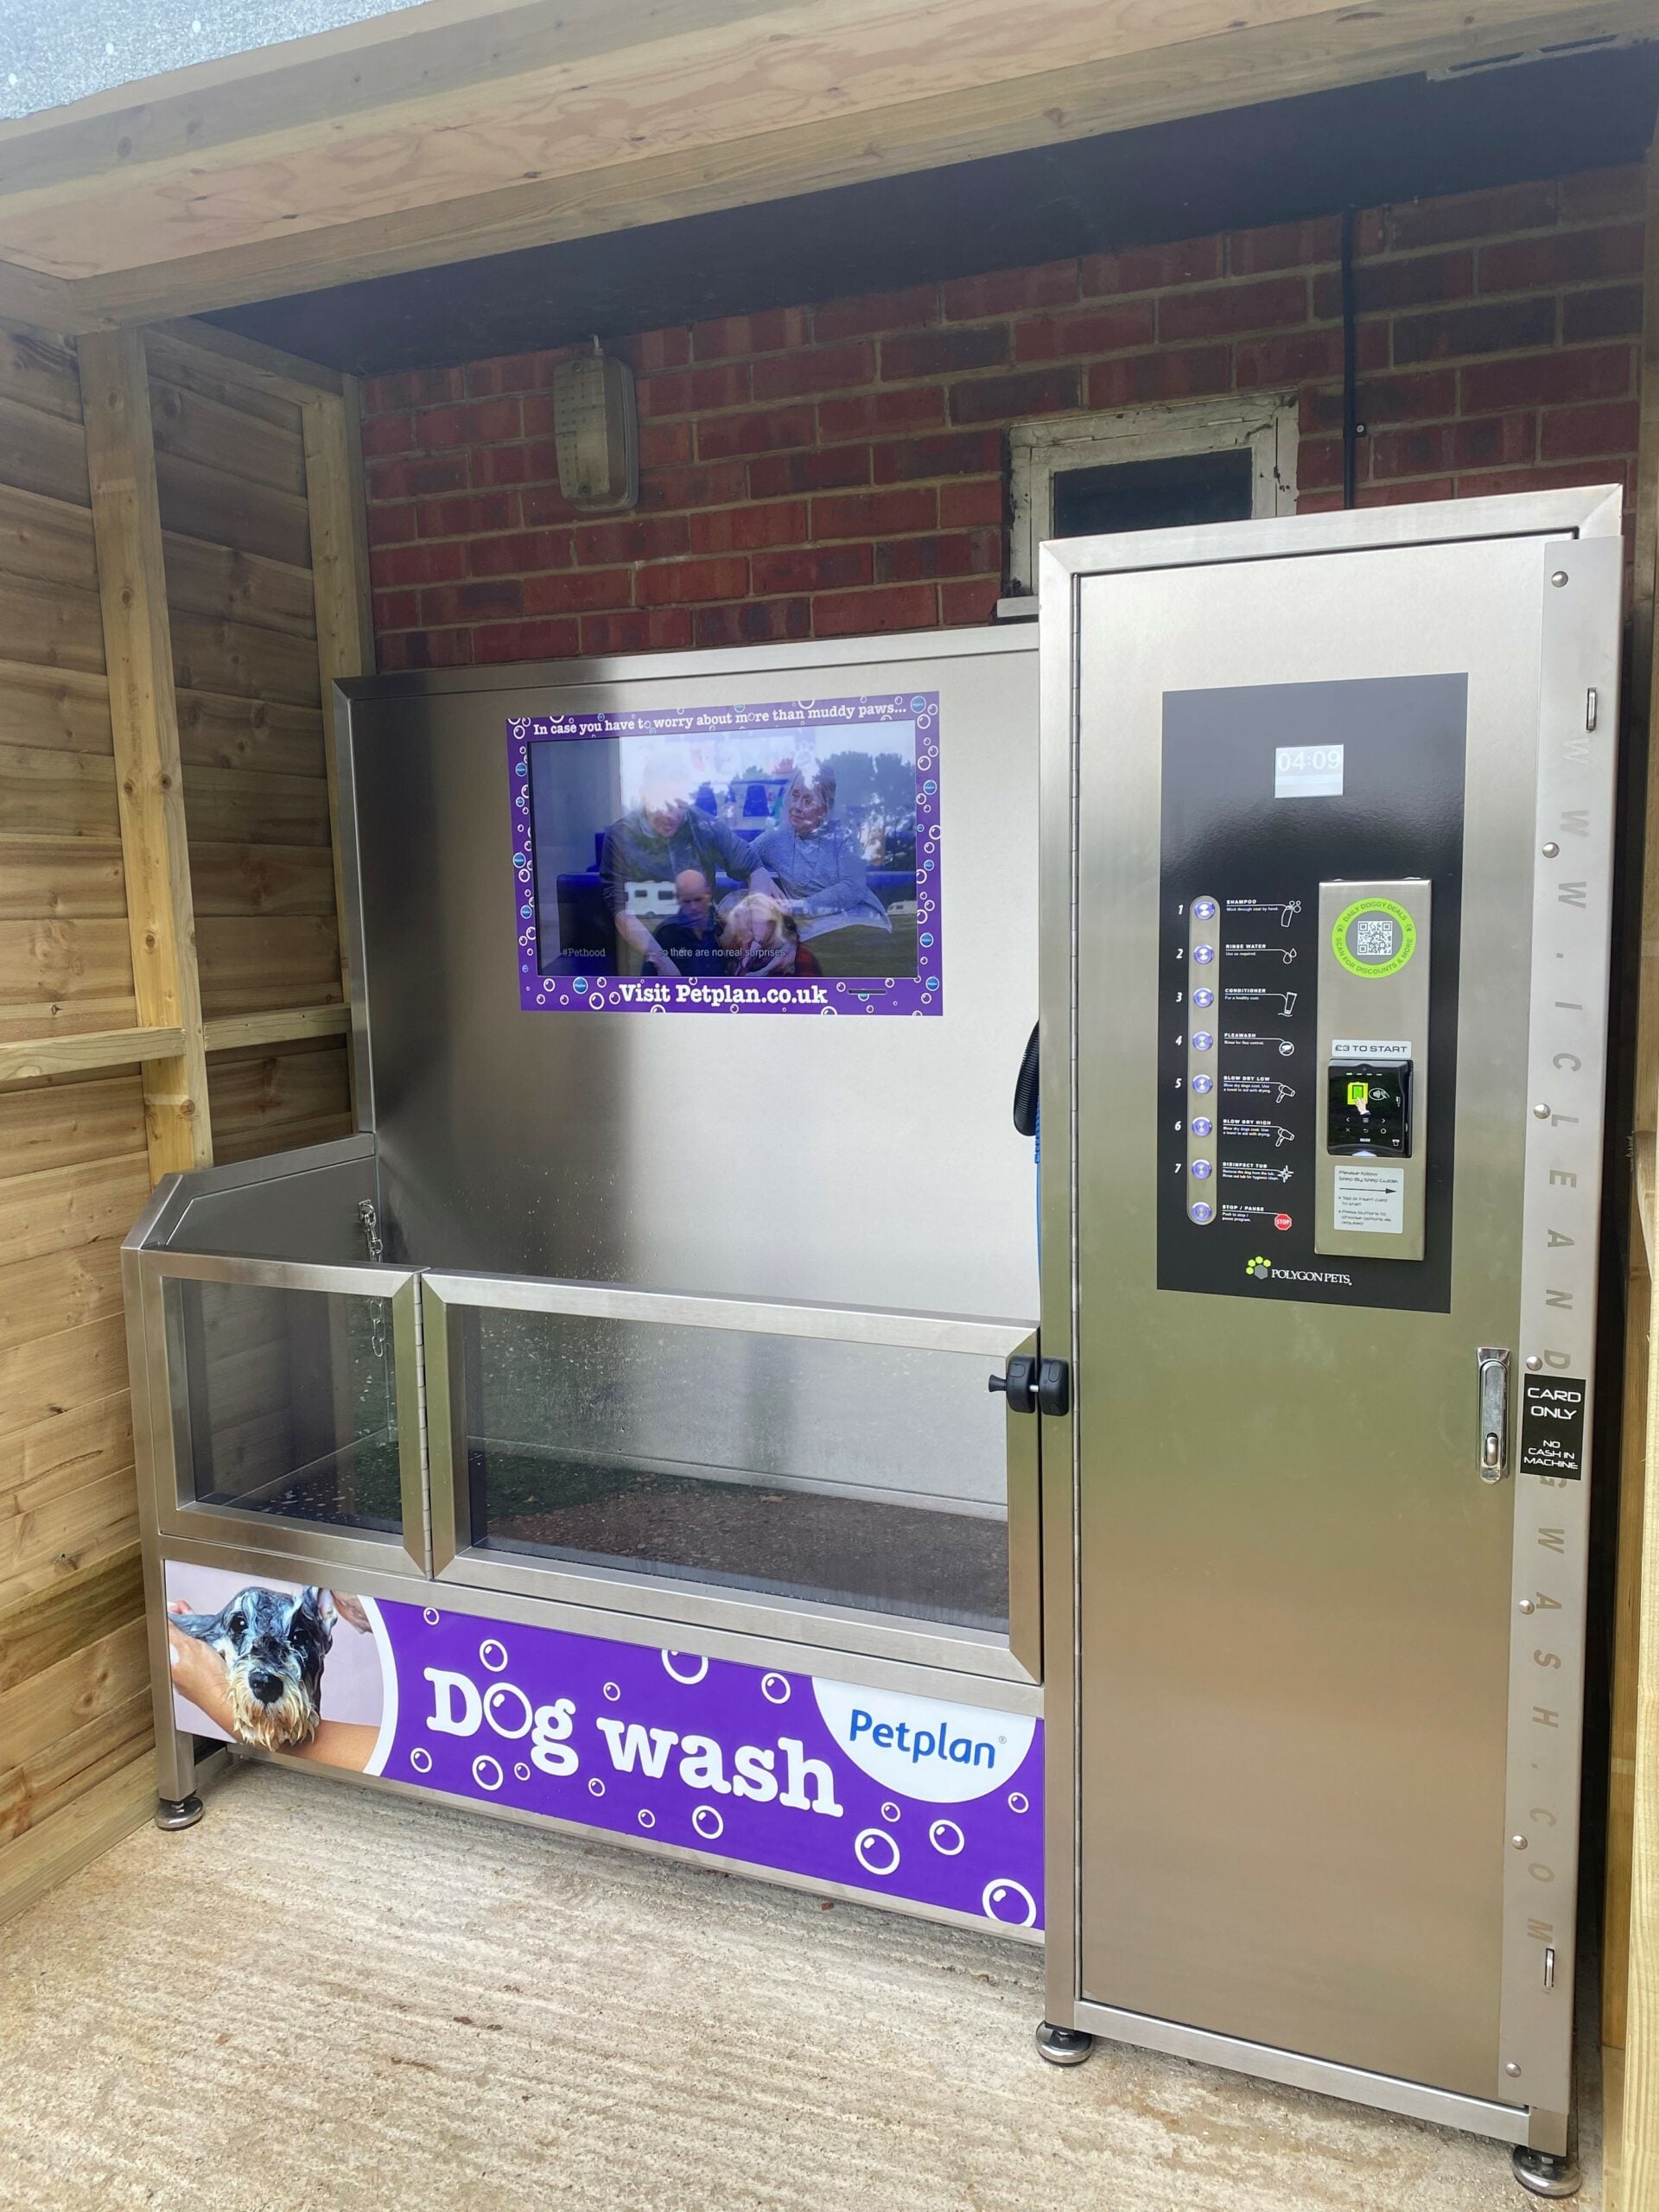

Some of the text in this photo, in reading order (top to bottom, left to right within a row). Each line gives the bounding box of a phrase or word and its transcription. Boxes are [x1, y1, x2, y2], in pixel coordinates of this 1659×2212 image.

[534, 724, 548, 734] In
[550, 724, 576, 734] case
[579, 722, 602, 735] you
[605, 720, 633, 731] have
[653, 717, 694, 729] worry
[696, 713, 733, 726] about
[735, 711, 769, 723] more
[772, 709, 804, 721] than
[808, 704, 855, 719] muddy
[857, 703, 907, 717] paws...
[1278, 750, 1340, 772] 04:09
[1178, 905, 1184, 915] 1
[1343, 907, 1359, 922] DAILY
[1388, 905, 1408, 921] DEALS
[563, 948, 606, 957] #Pethood
[671, 948, 693, 957] there
[726, 948, 742, 957] real
[1176, 949, 1183, 959] 2
[1343, 956, 1356, 968] FOR
[1356, 962, 1397, 974] DISCOUNTS
[1402, 938, 1413, 959] MORE
[619, 983, 828, 1007] Visit Petplan.co.uk
[1176, 992, 1183, 1002] 3
[1175, 1035, 1183, 1046] 4
[1175, 1078, 1182, 1089] 5
[1175, 1121, 1181, 1131] 6
[1175, 1164, 1182, 1173] 7
[1271, 1268, 1323, 1281] POLYGON
[1528, 1387, 1581, 1402] CARD
[1530, 1406, 1577, 1420] ONLY
[1529, 1447, 1560, 1458] CASH
[1523, 1457, 1578, 1469] MACHINE
[423, 1667, 843, 1817] Dog wash
